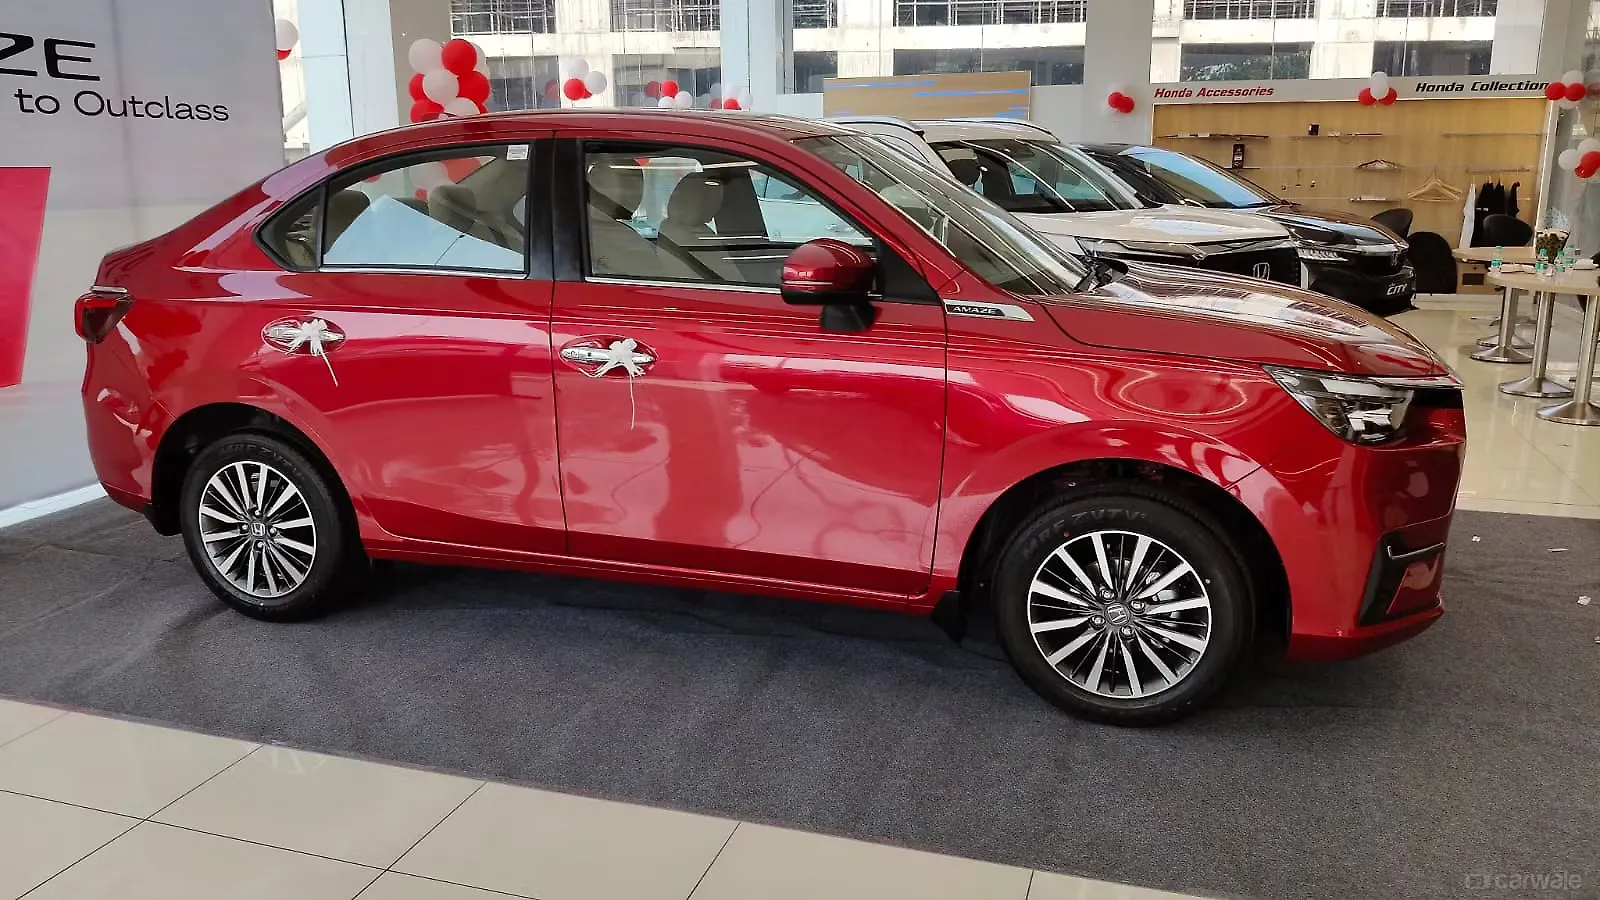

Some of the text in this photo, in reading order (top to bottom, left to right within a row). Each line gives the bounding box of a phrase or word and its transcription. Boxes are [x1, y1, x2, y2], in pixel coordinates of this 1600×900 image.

[1154, 86, 1274, 98] Honda Accessories
[1415, 80, 1550, 92] Honda Collection
[14, 88, 230, 121] to Outclass
[1386, 283, 1408, 296] CITY
[953, 306, 997, 315] AMAZE
